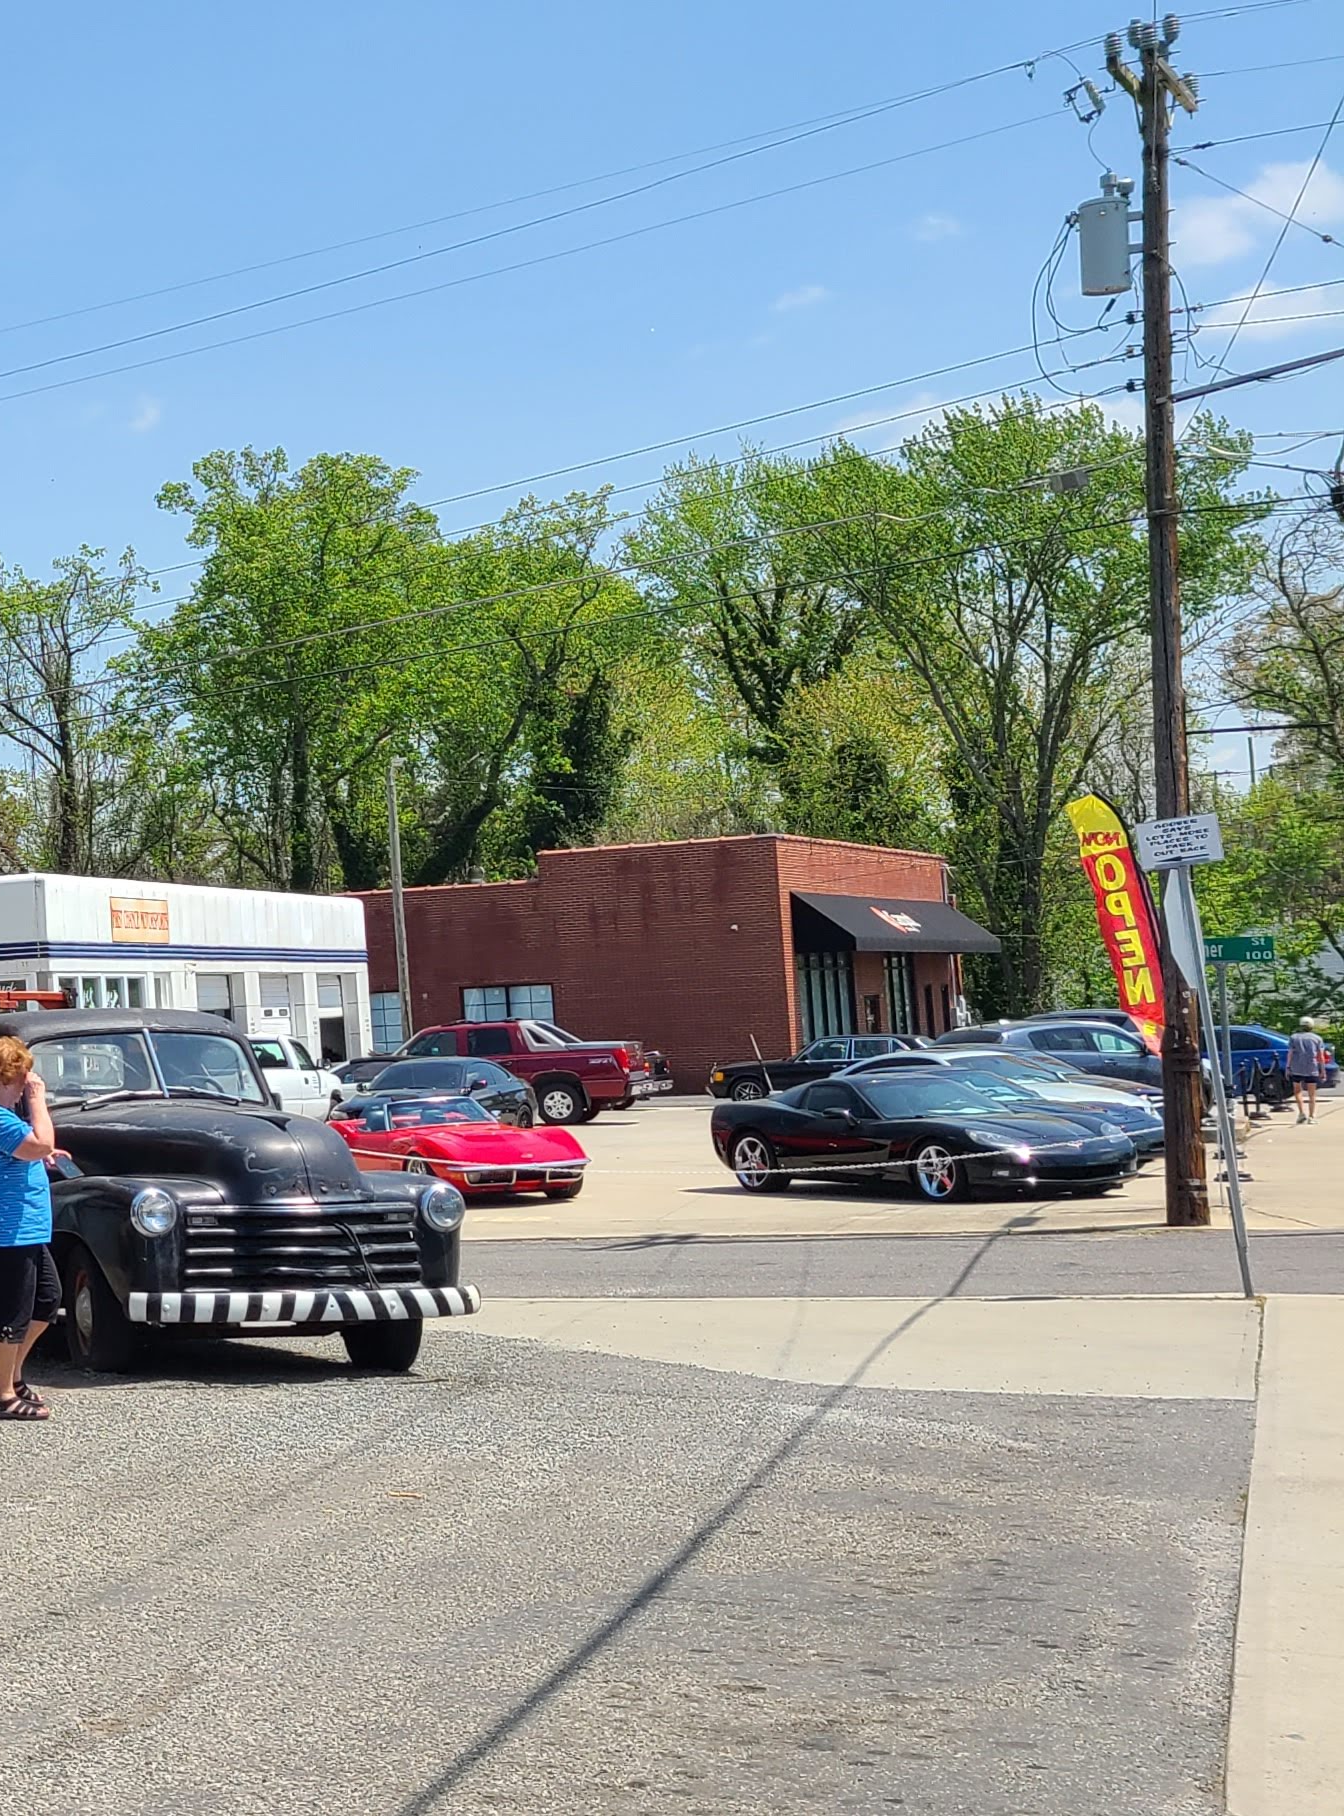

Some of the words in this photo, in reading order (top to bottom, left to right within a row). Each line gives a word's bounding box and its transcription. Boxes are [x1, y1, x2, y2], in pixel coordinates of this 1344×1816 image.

[1154, 849, 1175, 857] OUT
[1251, 938, 1265, 946] St
[1246, 951, 1272, 960] 100
